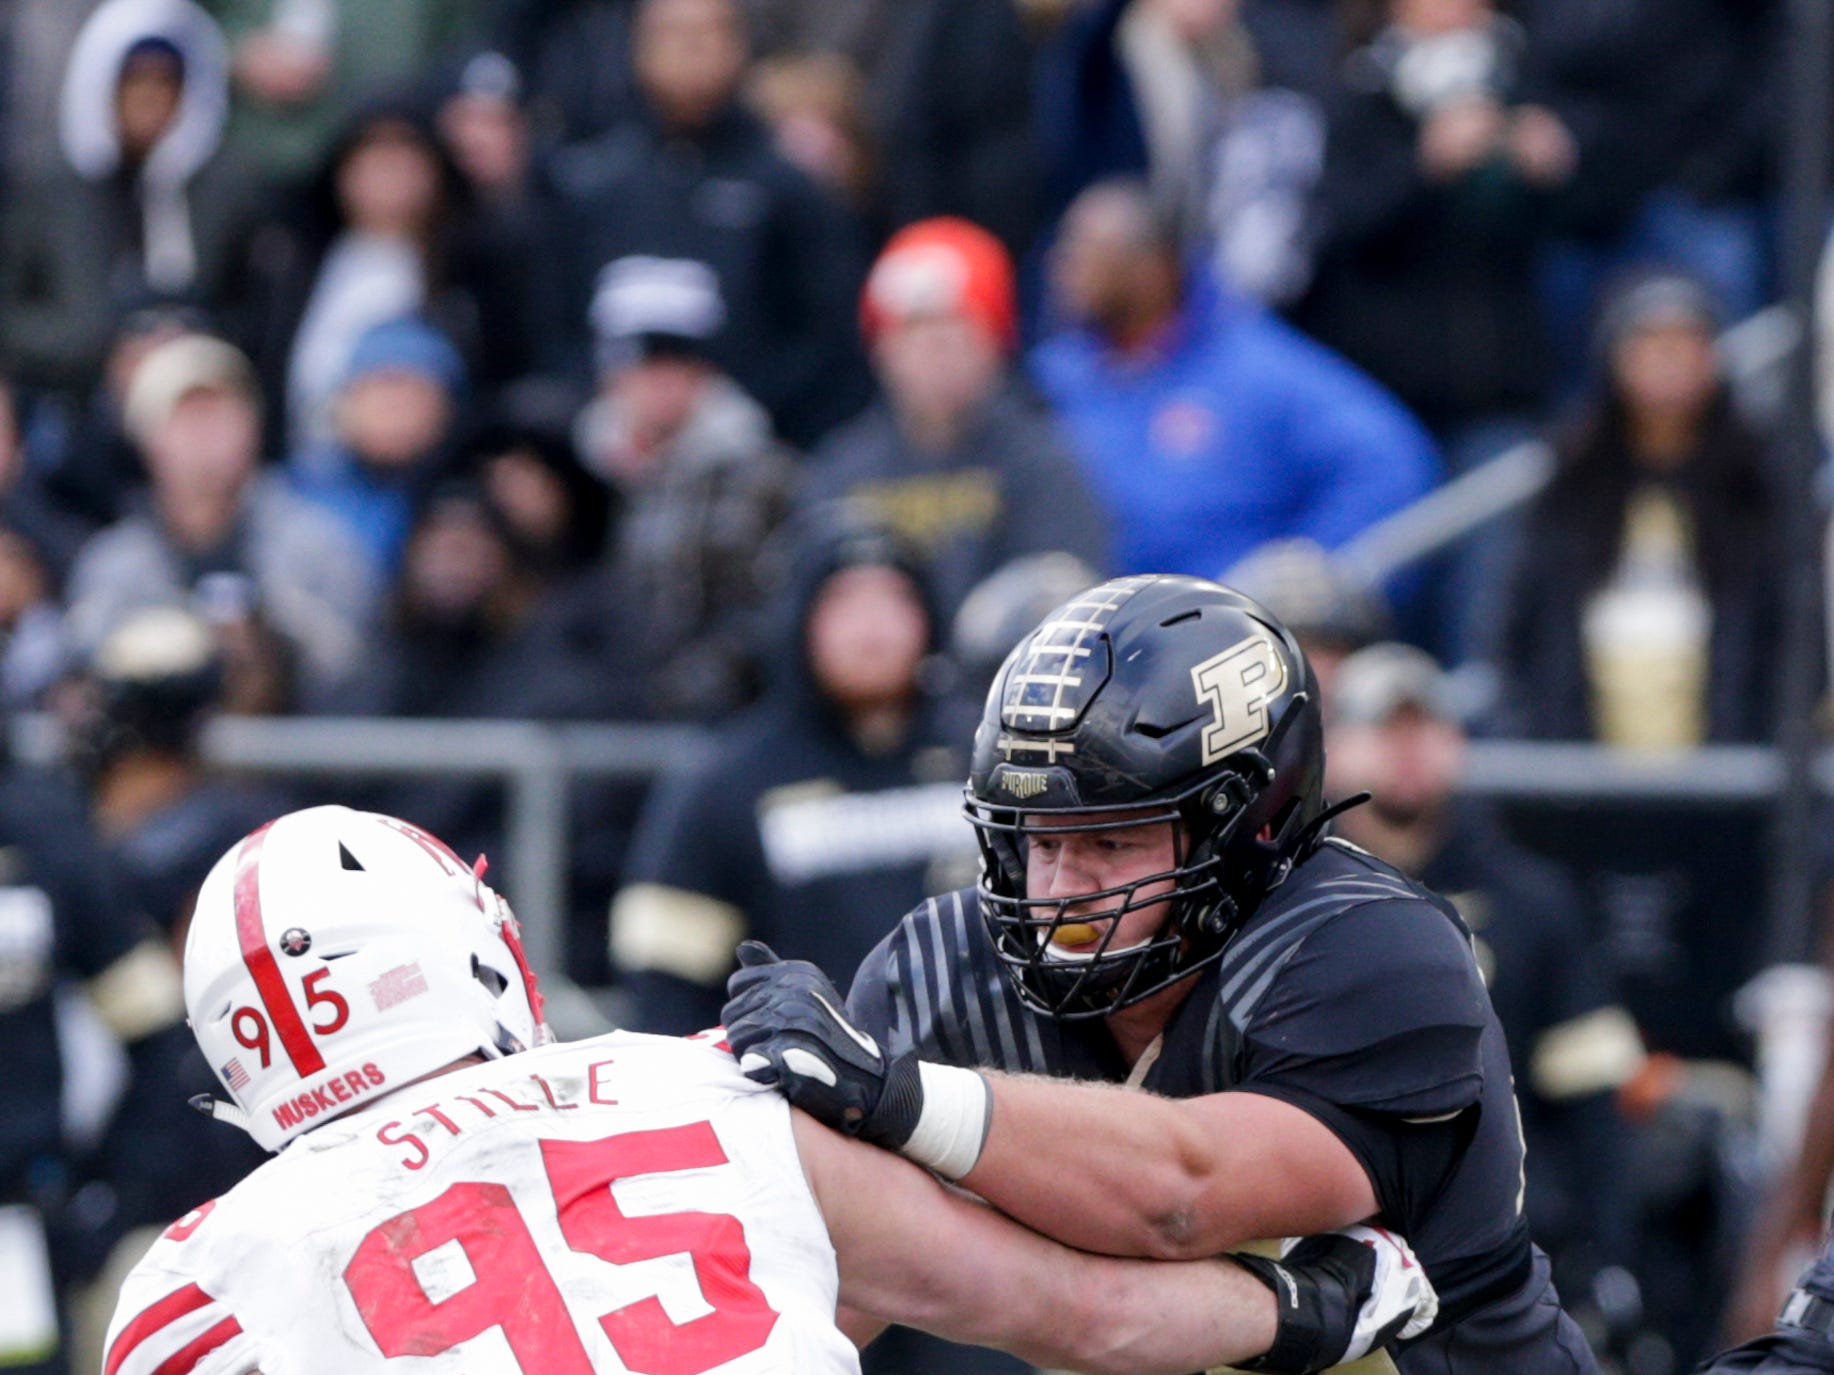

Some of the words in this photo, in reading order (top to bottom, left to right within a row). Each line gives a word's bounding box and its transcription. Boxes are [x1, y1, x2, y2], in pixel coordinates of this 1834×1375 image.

[1001, 770, 1048, 799] PURDUE
[272, 1062, 385, 1130] HUSKERS
[376, 1060, 618, 1170] STILLE
